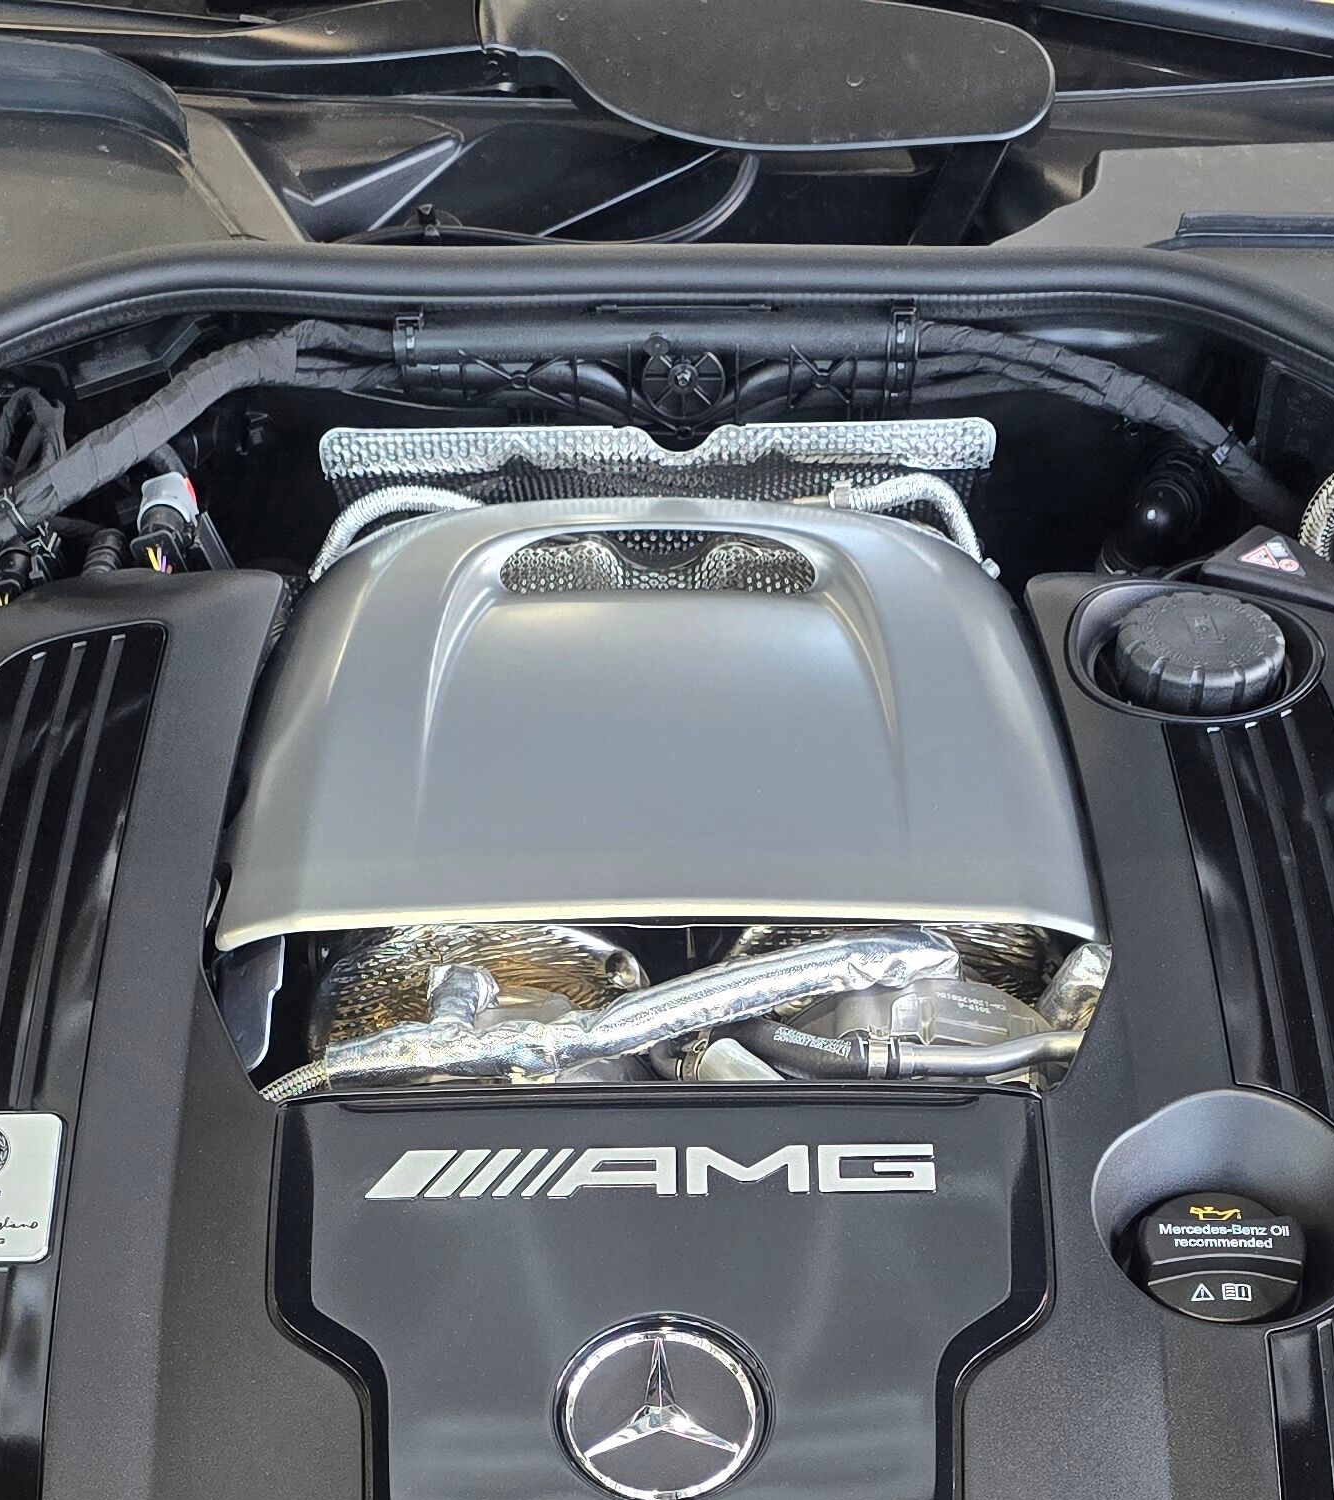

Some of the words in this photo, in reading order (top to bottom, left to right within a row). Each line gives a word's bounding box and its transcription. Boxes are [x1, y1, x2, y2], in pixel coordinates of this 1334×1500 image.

[548, 1143, 936, 1199] AMG
[1158, 1223, 1268, 1237] Mercedes-Benz
[1270, 1225, 1290, 1237] Oil
[1173, 1237, 1274, 1249] recommended
